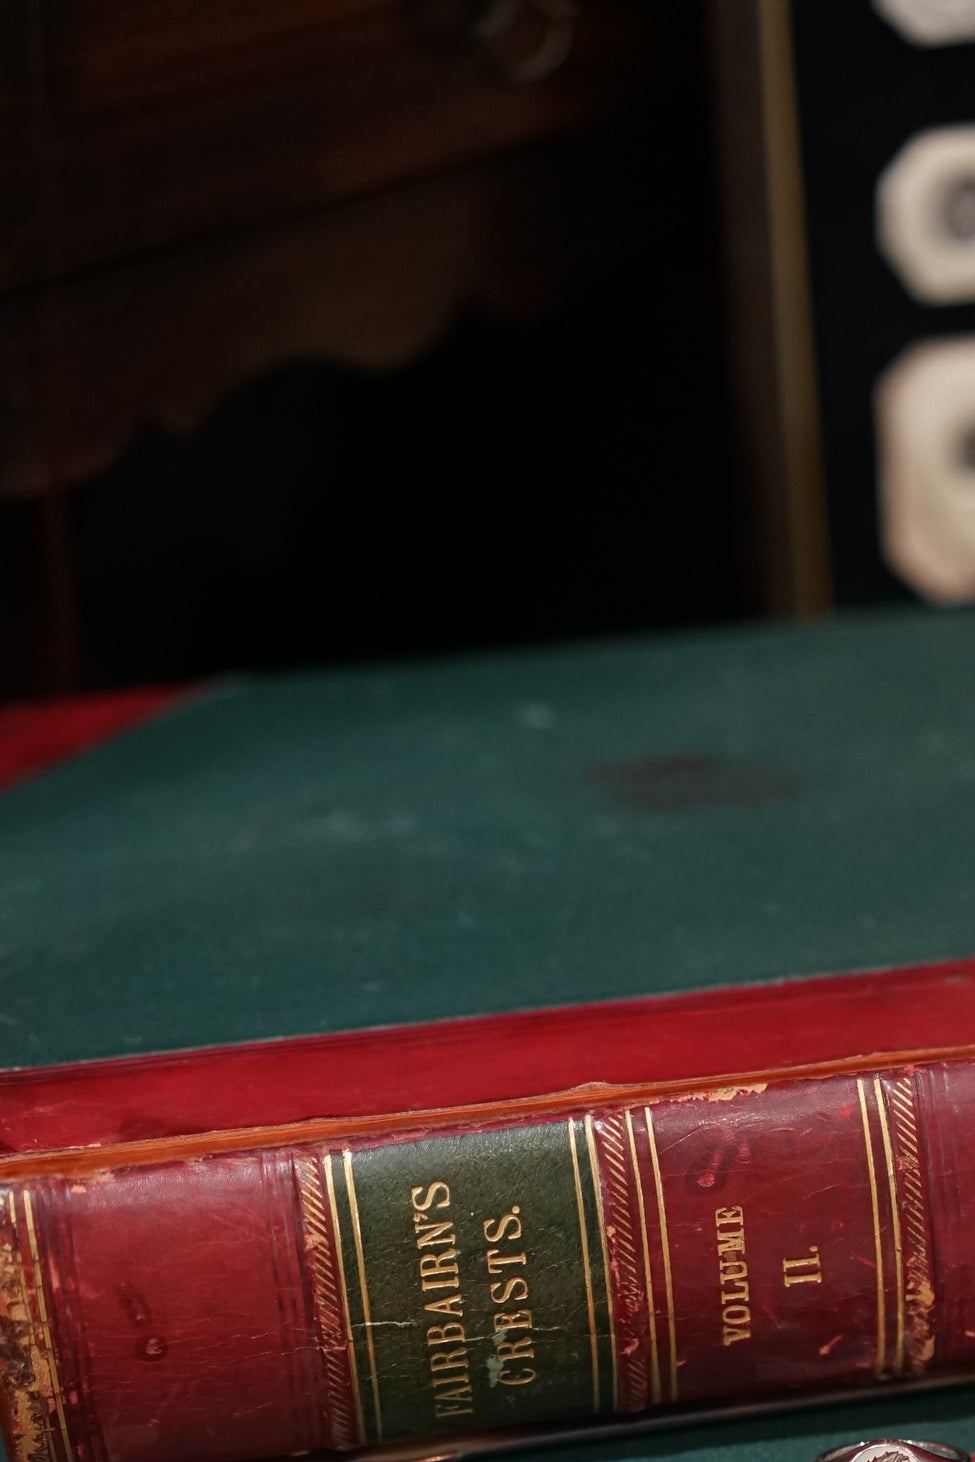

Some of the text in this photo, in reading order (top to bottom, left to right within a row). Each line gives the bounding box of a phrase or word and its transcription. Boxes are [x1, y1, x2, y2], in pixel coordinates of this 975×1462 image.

[411, 1181, 473, 1419] FAIRBAIRN'S
[484, 1205, 536, 1386] CRESTS.
[715, 1206, 751, 1346] VOLUME
[783, 1245, 822, 1287] II.
